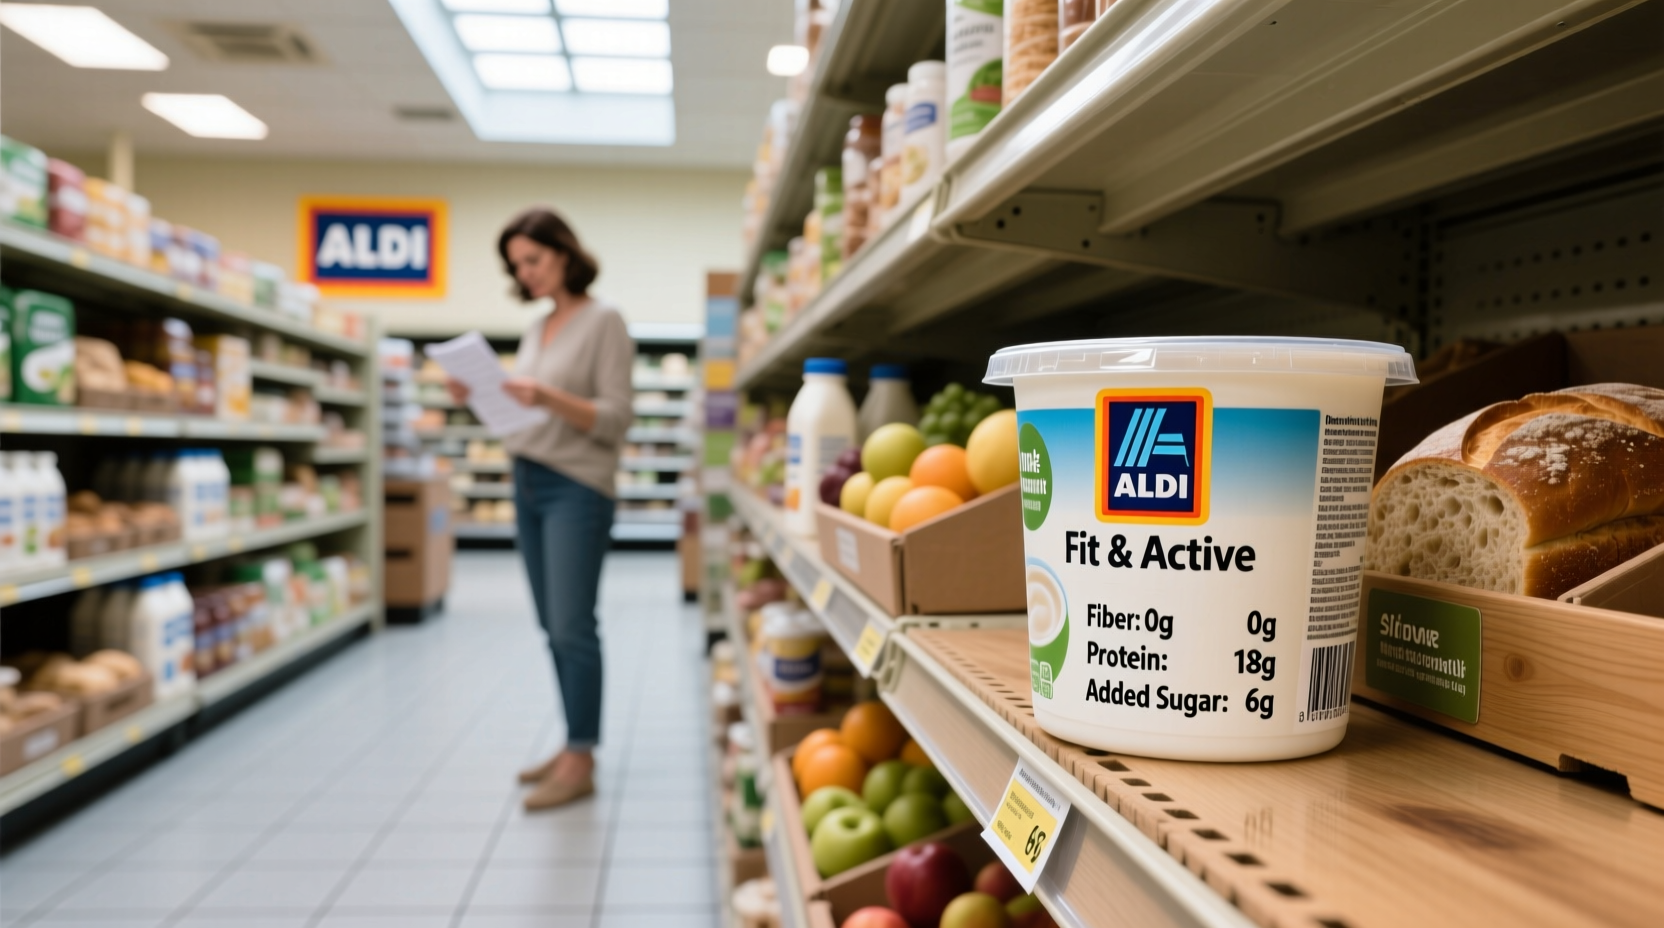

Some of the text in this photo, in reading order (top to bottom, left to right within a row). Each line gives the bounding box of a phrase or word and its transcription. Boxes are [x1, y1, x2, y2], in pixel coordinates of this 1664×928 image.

[317, 223, 429, 270] ALDI
[1113, 472, 1188, 499] ALDI
[1065, 530, 1256, 572] Fit & Active
[1086, 603, 1277, 643] Fiber: 0g 0g
[1086, 641, 1276, 682] Protein: 18g
[1085, 678, 1150, 709] Added
[1155, 684, 1229, 718] Sugar:
[1244, 687, 1275, 720] 6g
